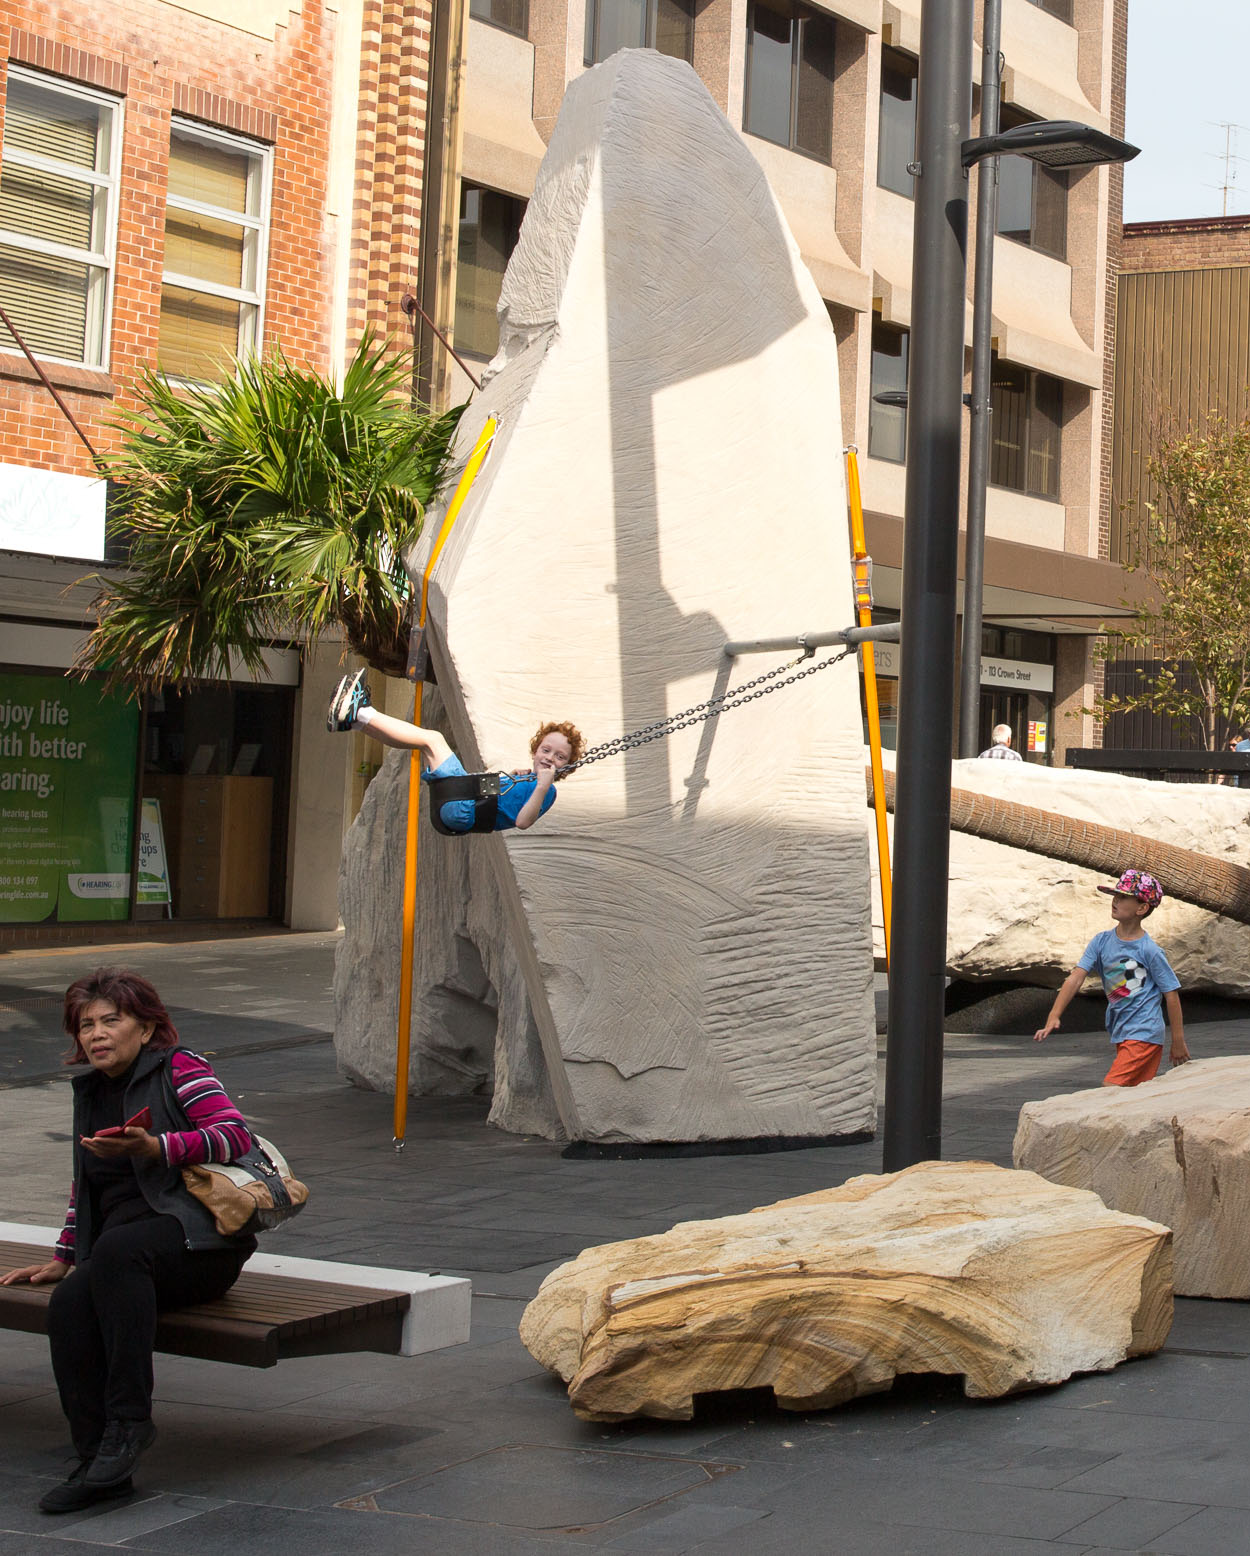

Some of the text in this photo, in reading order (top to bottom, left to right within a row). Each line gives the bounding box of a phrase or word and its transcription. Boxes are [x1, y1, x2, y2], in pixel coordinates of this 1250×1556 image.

[997, 667, 1015, 679] Crown
[1016, 669, 1031, 681] Street
[40, 699, 69, 726] life
[30, 732, 87, 760] better
[0, 768, 55, 799] aring.
[2, 807, 48, 821] hearing tests
